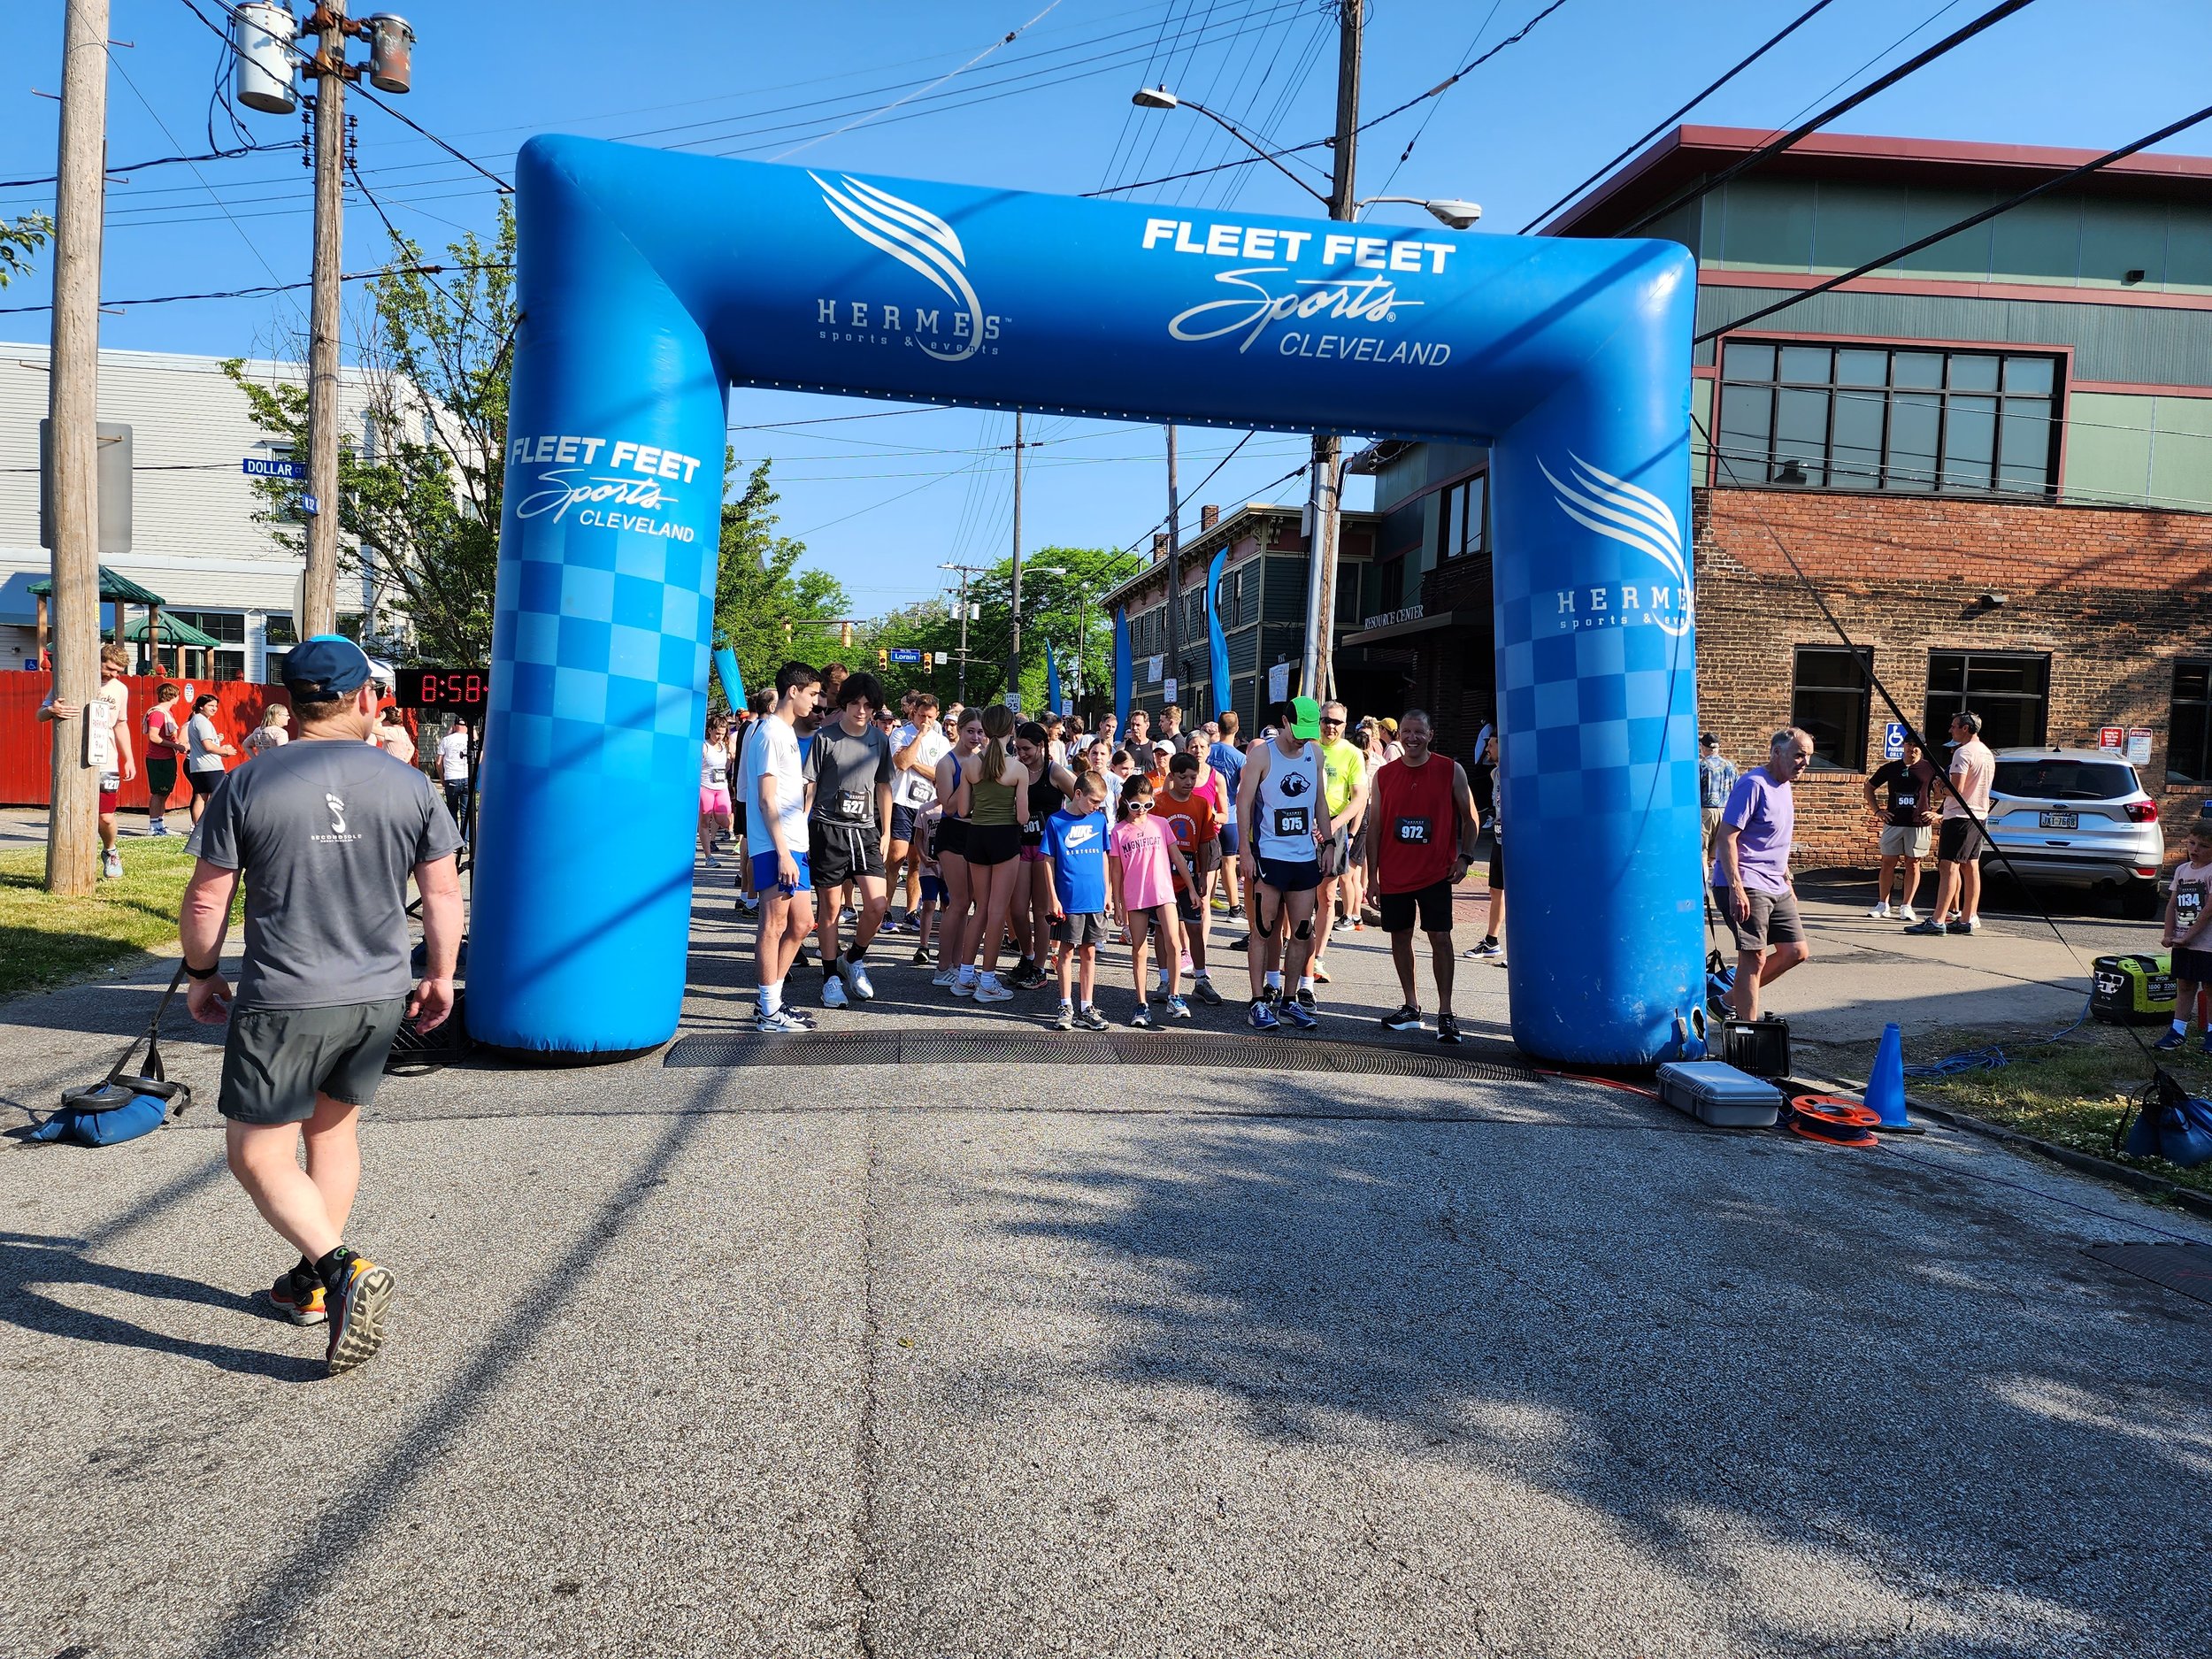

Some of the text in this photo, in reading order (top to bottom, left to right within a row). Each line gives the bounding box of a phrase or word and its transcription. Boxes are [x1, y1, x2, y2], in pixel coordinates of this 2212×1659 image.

[1142, 219, 1456, 274] FLEET FEET
[818, 298, 1000, 340] HERMES
[1168, 267, 1425, 354] Sports
[819, 330, 998, 355] sports & events
[1279, 332, 1451, 366] CLEVELAND
[248, 460, 292, 476] DOLLAR
[511, 435, 701, 484] FLEET FEET
[517, 468, 679, 524] Sports
[580, 510, 694, 542] CLEVELAND
[1557, 587, 1694, 613] HERME
[1364, 604, 1424, 630] RESOURCE CENTER
[1560, 615, 1627, 629] sports
[1643, 613, 1652, 624] &
[96, 707, 104, 718] NO
[842, 800, 864, 814] 527
[1024, 820, 1041, 833] 501
[1070, 825, 1093, 838] NIKE
[1282, 817, 1302, 831] 975
[1402, 826, 1424, 838] 972
[1122, 836, 1160, 854] MAGNIFICAT
[2177, 894, 2200, 906] 1134
